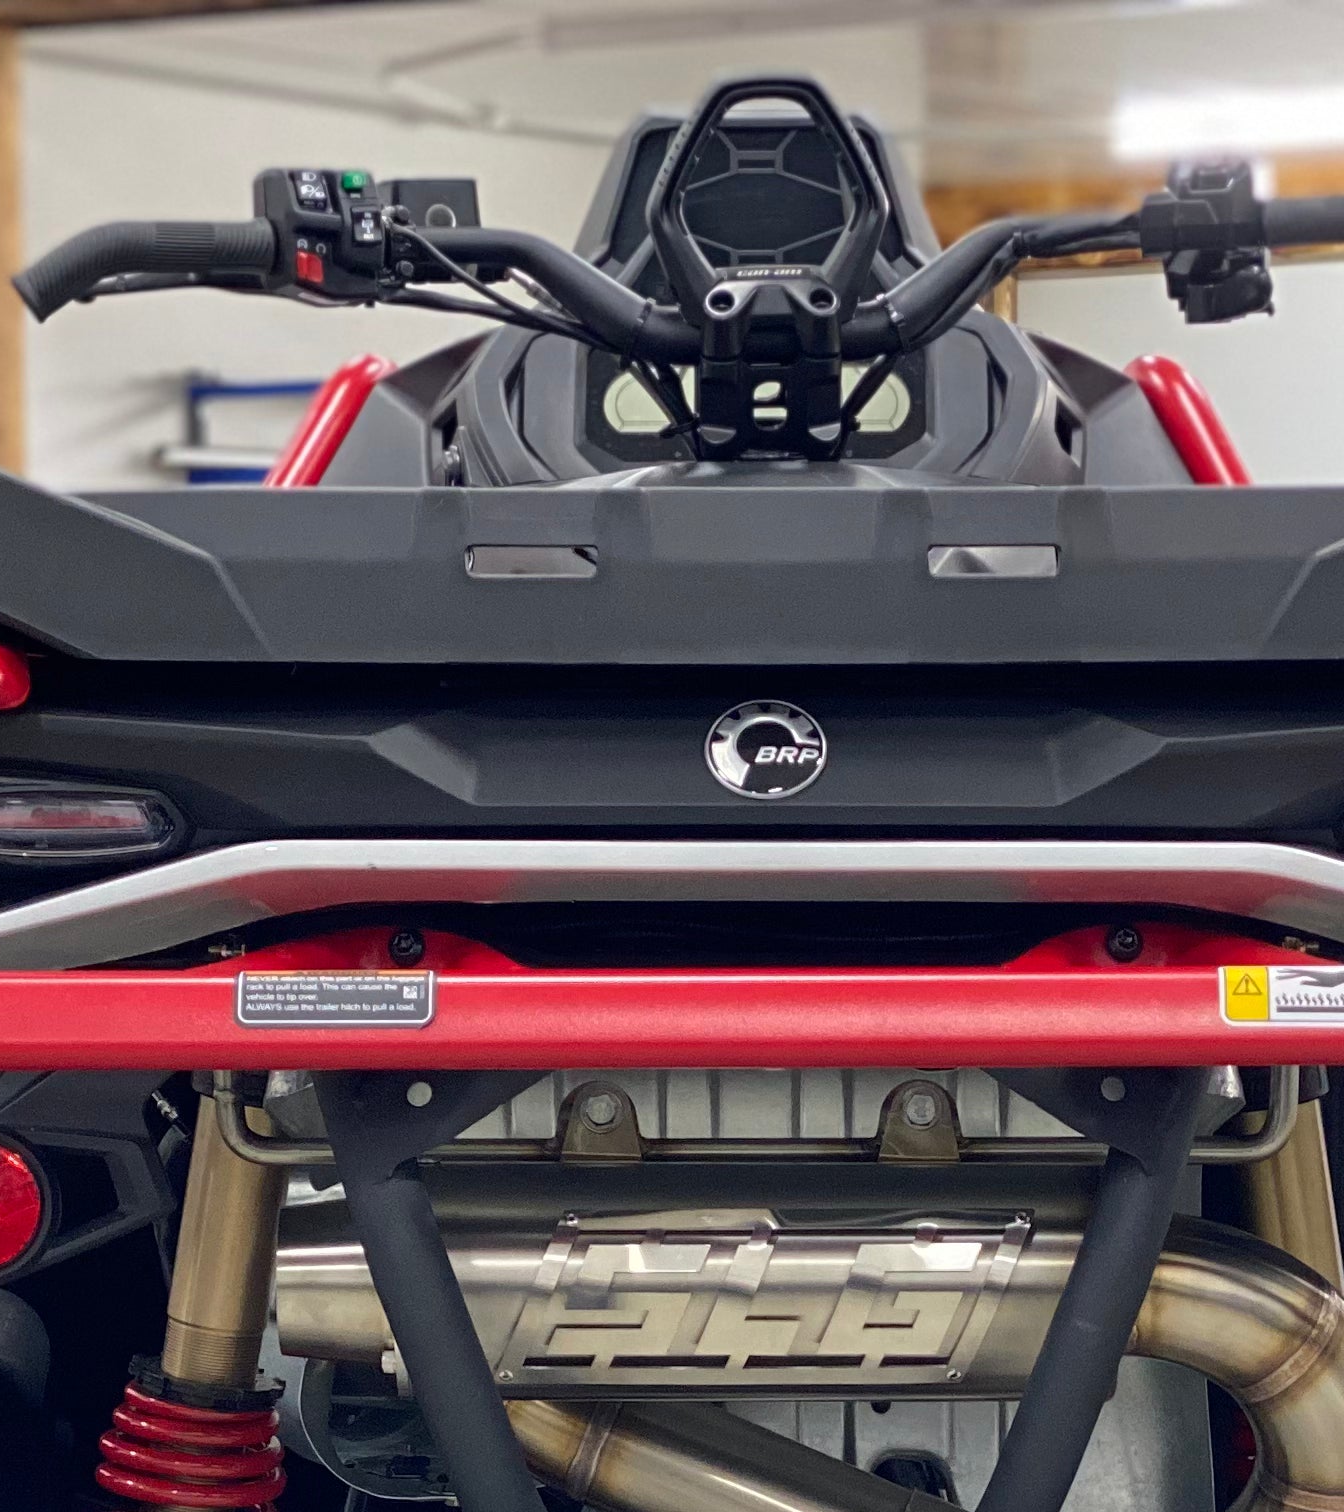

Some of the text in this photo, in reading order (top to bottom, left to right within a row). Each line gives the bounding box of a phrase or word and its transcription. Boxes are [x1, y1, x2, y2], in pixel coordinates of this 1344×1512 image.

[754, 745, 820, 765] BRP
[276, 983, 291, 991] pull
[322, 983, 339, 991] This
[286, 993, 297, 1001] tip
[316, 1003, 339, 1011] trailer
[372, 1003, 387, 1011] pull
